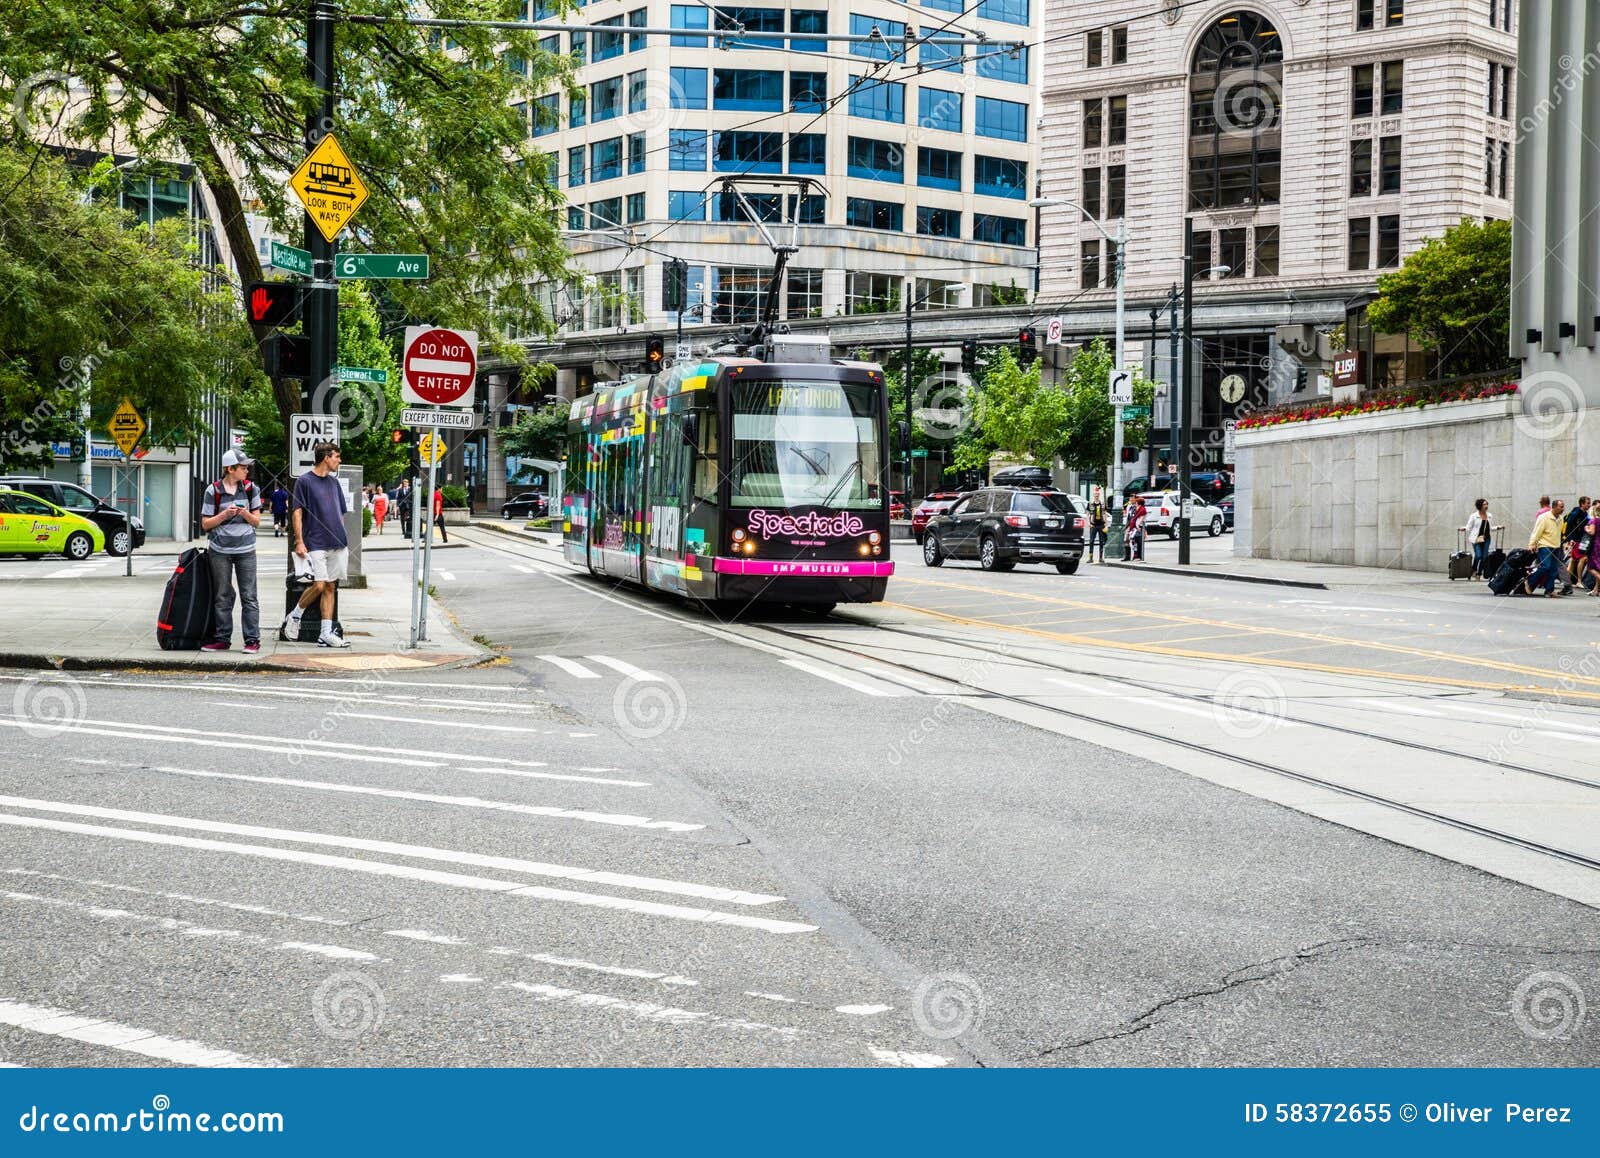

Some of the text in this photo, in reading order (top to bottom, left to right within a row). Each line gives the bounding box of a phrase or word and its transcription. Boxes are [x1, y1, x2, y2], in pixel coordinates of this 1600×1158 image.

[307, 197, 352, 212] LOOK BOTH
[319, 211, 341, 222] WAYS
[273, 245, 297, 269] Westlake
[397, 261, 420, 273] Ave
[419, 342, 466, 358] DO NOT
[341, 367, 372, 380] Stewart
[418, 376, 461, 391] ENTER
[768, 386, 842, 409] LAKE UNION
[404, 412, 470, 425] EXCEPT STREETCAR
[297, 419, 333, 435] ONE
[296, 437, 335, 452] WA
[868, 498, 882, 506] 302
[748, 509, 878, 540] Spectacle
[773, 564, 850, 573] EMP MUSEUM
